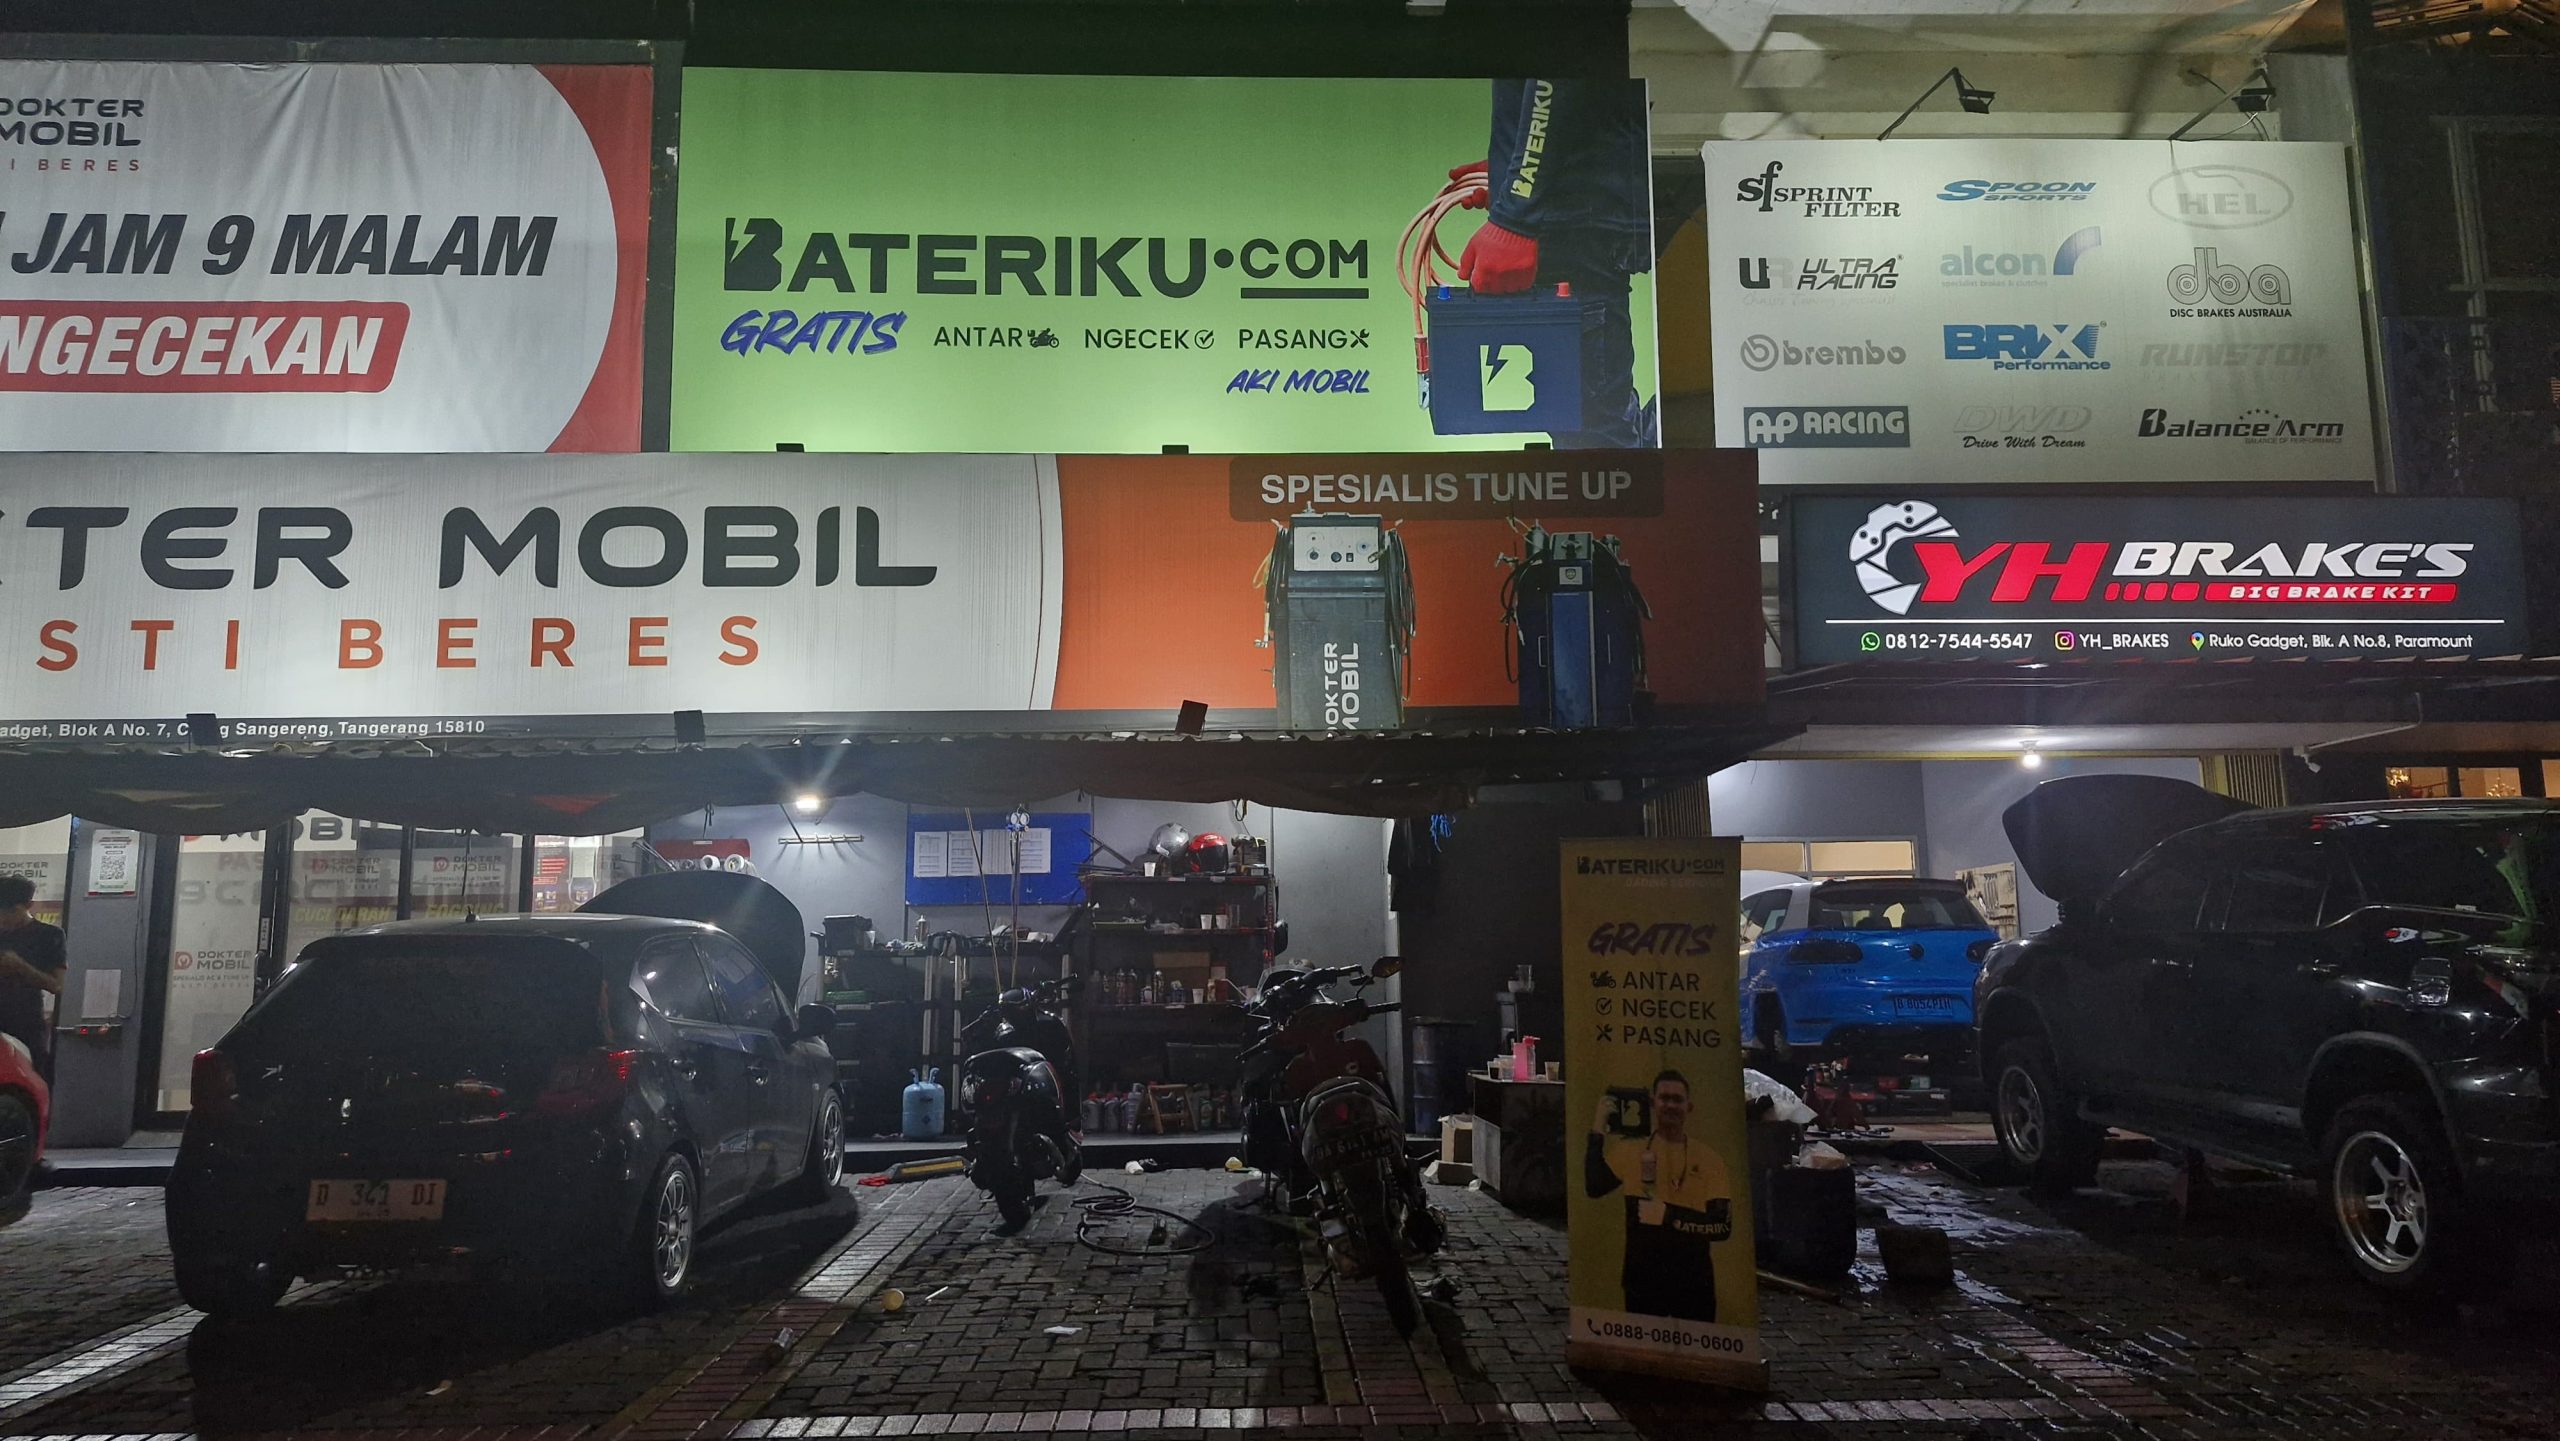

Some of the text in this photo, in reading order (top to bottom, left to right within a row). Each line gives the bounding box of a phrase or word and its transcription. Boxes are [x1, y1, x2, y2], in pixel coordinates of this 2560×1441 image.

[38, 158, 139, 171] BERES
[1774, 187, 1872, 202] SPRINT
[1937, 180, 2096, 201] SPOON
[1804, 202, 1901, 217] FILTER
[11, 213, 558, 276] JAM 9 MALAM
[1803, 258, 1897, 273] ULTRA
[1940, 245, 2047, 276] alcon
[1797, 273, 1899, 290] RACING
[2167, 247, 2291, 305] dba
[2170, 309, 2292, 318] DISC BRAKES AUSTRALIA
[721, 309, 907, 356] GRATIS
[933, 326, 1347, 350] ANTAR NGECEK PASANG
[0, 315, 383, 376] NGECEKAN
[1783, 340, 1906, 365] brembo
[1994, 360, 2111, 371] Performance
[1226, 369, 1370, 394] AKI MOBIL
[1749, 411, 1905, 443] AP RACING
[1953, 405, 2092, 433] DWD
[2138, 408, 2344, 437] Balance Arm
[1963, 435, 2086, 448] Drive With Dream
[1261, 471, 1632, 504] SPESIALIS TUNE UP
[0, 505, 937, 590] TER MOBIL
[1913, 542, 2474, 602] YH BRAKE'S
[2230, 586, 2431, 599] BIG BRAKE KIT
[338, 615, 760, 670] BERES
[1885, 632, 2033, 649] 0812-7544-5547
[2079, 633, 2170, 650] YH_BRAKES
[2209, 634, 2473, 649] Ruko Gadget, Blk. A No.8, Paramount
[1323, 642, 1339, 730] OKTER
[59, 723, 98, 737] Blok
[104, 724, 116, 737] A
[122, 724, 150, 737] No.
[156, 723, 171, 739] 7,
[235, 722, 334, 738] Sangereng,
[338, 721, 429, 736] Tangerang
[435, 720, 485, 735] 15810
[0, 861, 48, 870] DOKTER
[1588, 922, 1718, 957] GRATIS
[197, 959, 250, 970] MOBIL
[1622, 971, 1700, 991] ANTAR
[1622, 998, 1717, 1021] NGECEK
[1623, 1025, 1721, 1048] PASANG
